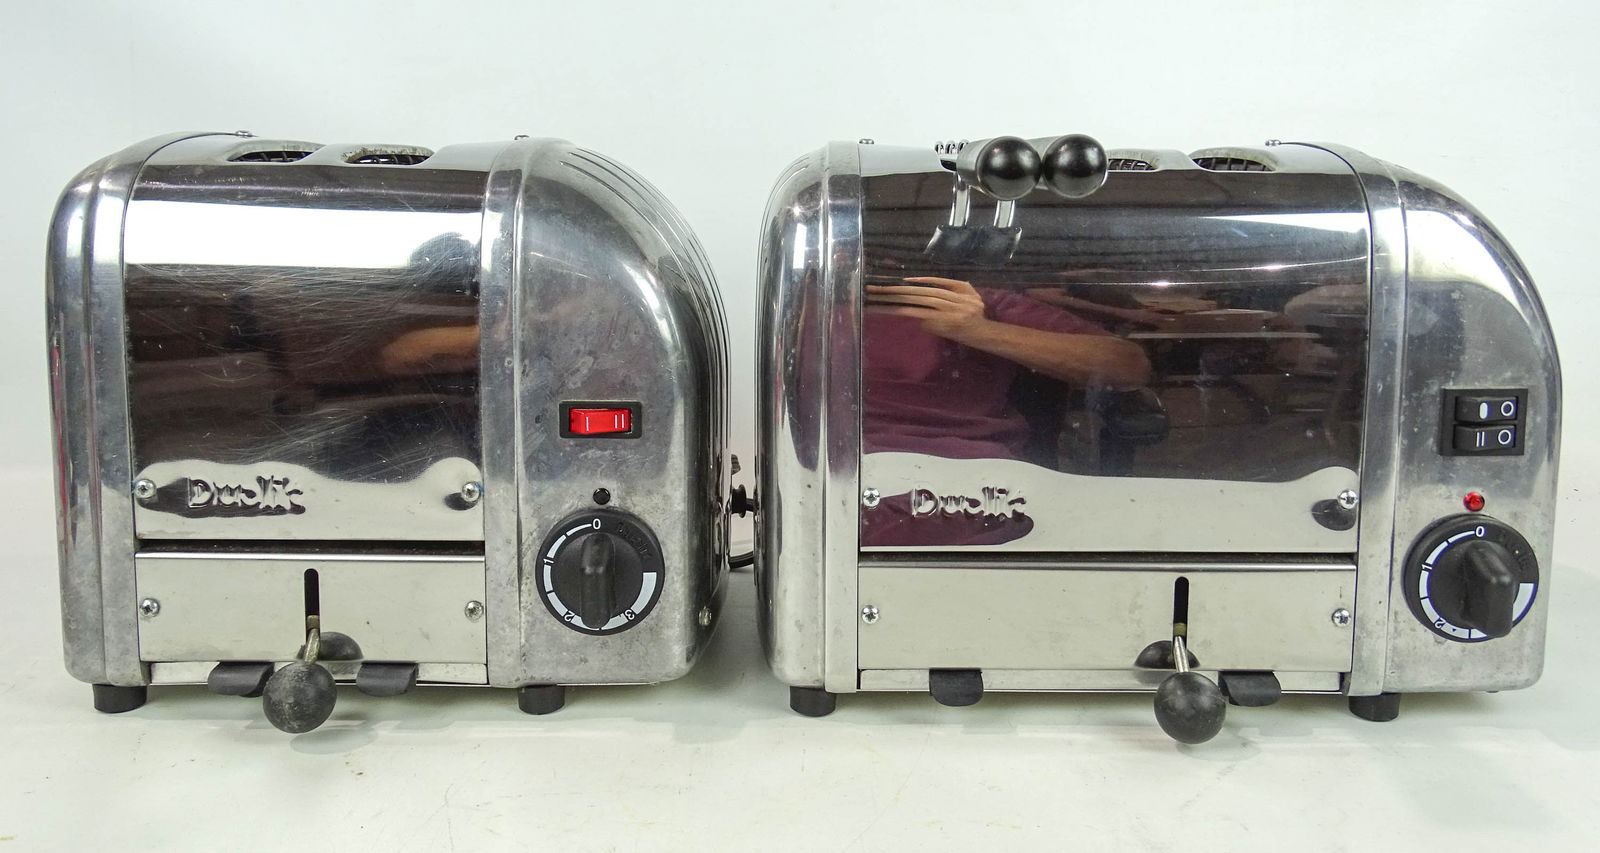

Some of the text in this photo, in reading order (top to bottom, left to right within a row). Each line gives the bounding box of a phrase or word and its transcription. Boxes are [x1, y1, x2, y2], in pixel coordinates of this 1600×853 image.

[564, 610, 575, 622] 2
[624, 609, 635, 620] 3
[1434, 617, 1447, 629] 2
